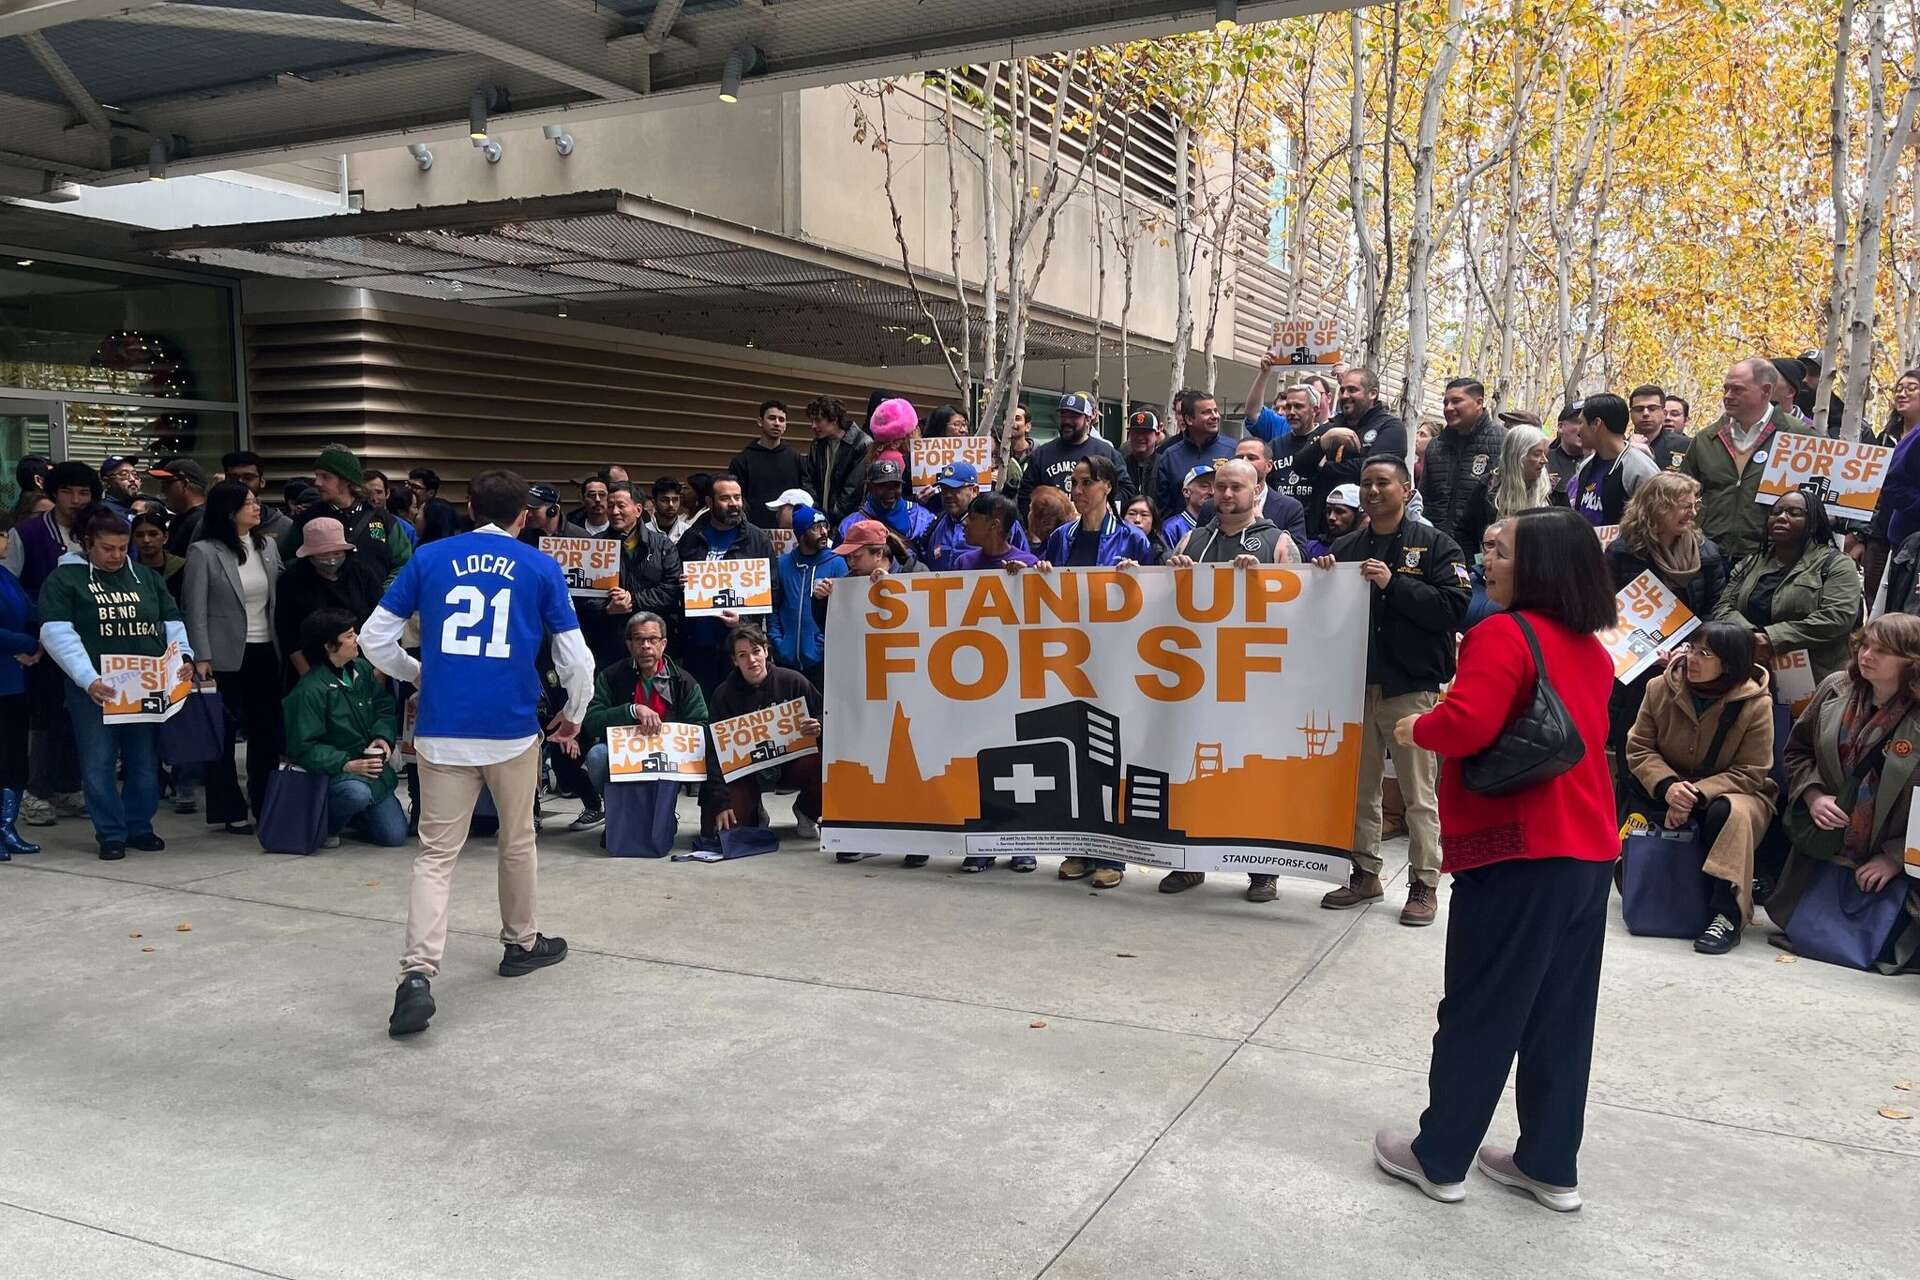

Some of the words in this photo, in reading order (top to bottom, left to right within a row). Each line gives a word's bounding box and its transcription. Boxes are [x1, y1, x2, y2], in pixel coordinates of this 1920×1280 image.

[1273, 321, 1314, 332] STAND
[1319, 320, 1338, 331] UP
[1272, 332, 1307, 347] FOR
[1314, 331, 1337, 346] SF
[914, 438, 962, 451] STAND
[967, 438, 987, 449] UP
[1777, 434, 1850, 457] STAND
[1856, 445, 1888, 462] UP
[914, 450, 955, 466] FOR
[962, 450, 987, 465] SF
[1771, 448, 1834, 476] FOR
[1841, 459, 1883, 482] SF
[1600, 528, 1619, 540] UP
[542, 539, 591, 551] STAND
[596, 541, 617, 552] UP
[452, 554, 516, 580] LOCAL
[590, 552, 616, 569] SF
[687, 561, 739, 574] STAND
[744, 559, 766, 571] UP
[687, 573, 733, 590] FOR
[740, 572, 766, 587] SF
[1624, 575, 1649, 599] UP
[865, 571, 1143, 629] STAND
[1174, 568, 1301, 623] UP
[1631, 585, 1663, 619] SF
[100, 623, 113, 636] IS
[441, 585, 511, 659] 21
[864, 628, 1098, 700] FOR
[1134, 626, 1288, 703] SF
[714, 709, 775, 736] STAND
[780, 700, 802, 717] UP
[678, 727, 700, 737] UP
[717, 725, 771, 752] FOR
[610, 735, 664, 754] FOR
[672, 736, 701, 753] SF
[1222, 854, 1328, 872] STANDUPFORSF.COM
